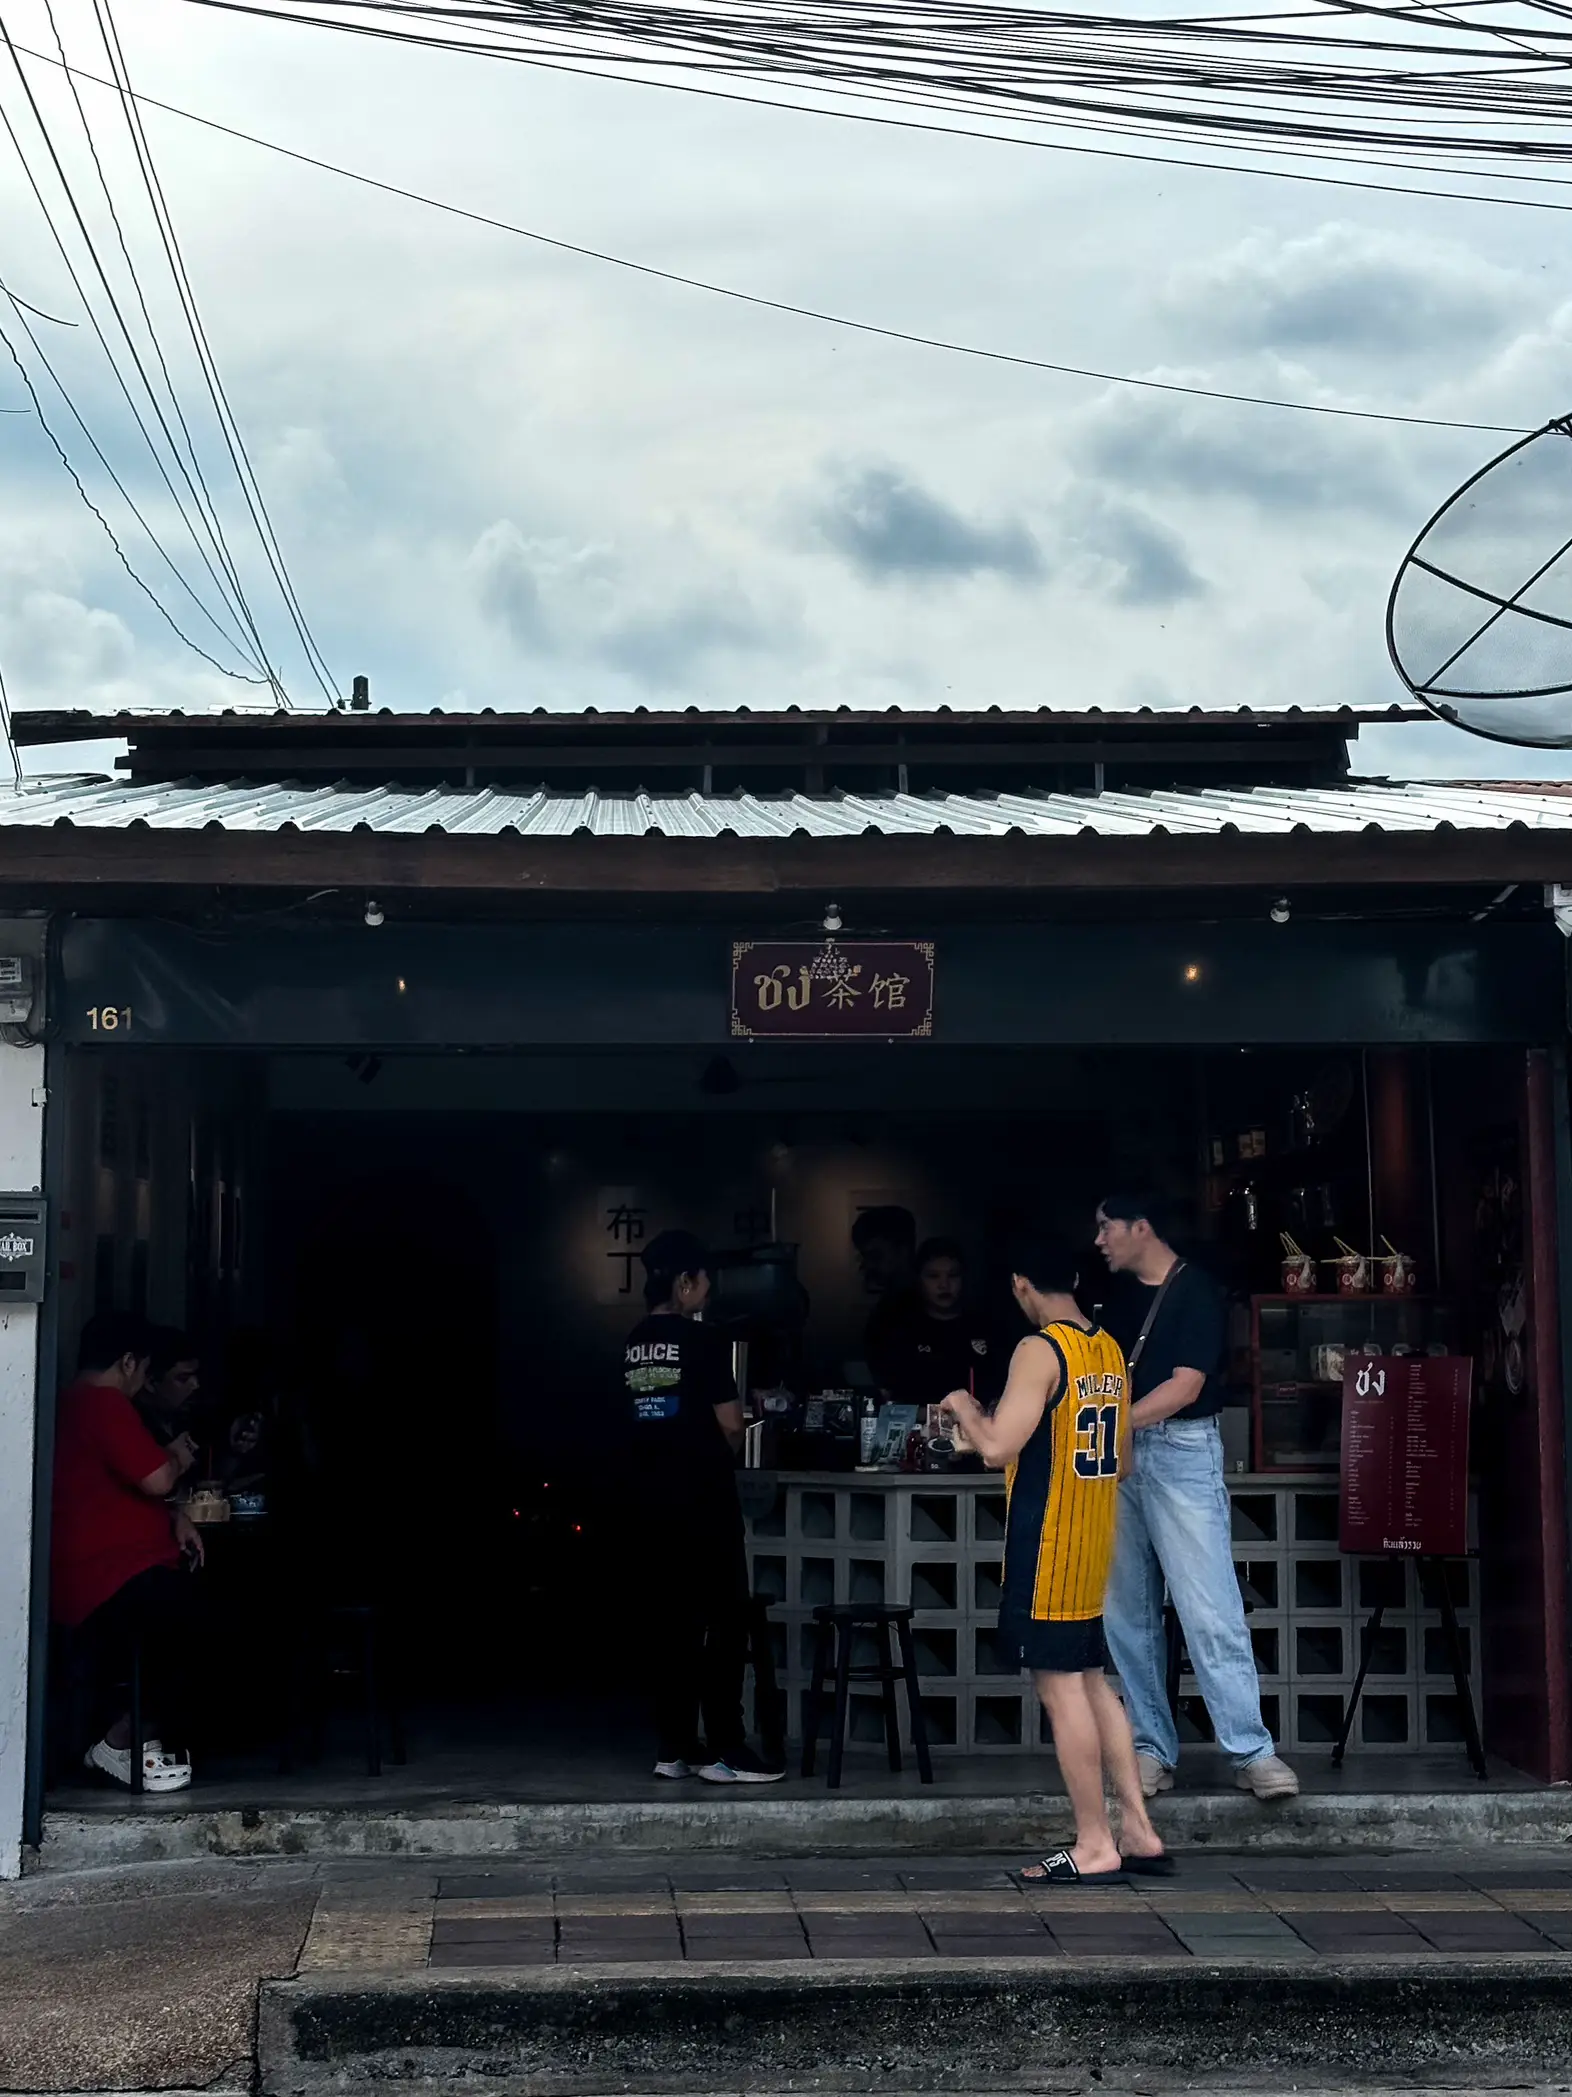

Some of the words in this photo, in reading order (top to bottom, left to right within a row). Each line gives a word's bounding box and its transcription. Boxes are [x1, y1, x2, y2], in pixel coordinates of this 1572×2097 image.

[86, 1006, 133, 1031] 161
[0, 1241, 12, 1252] AIL
[13, 1241, 27, 1252] BOX
[1072, 1403, 1119, 1479] 31
